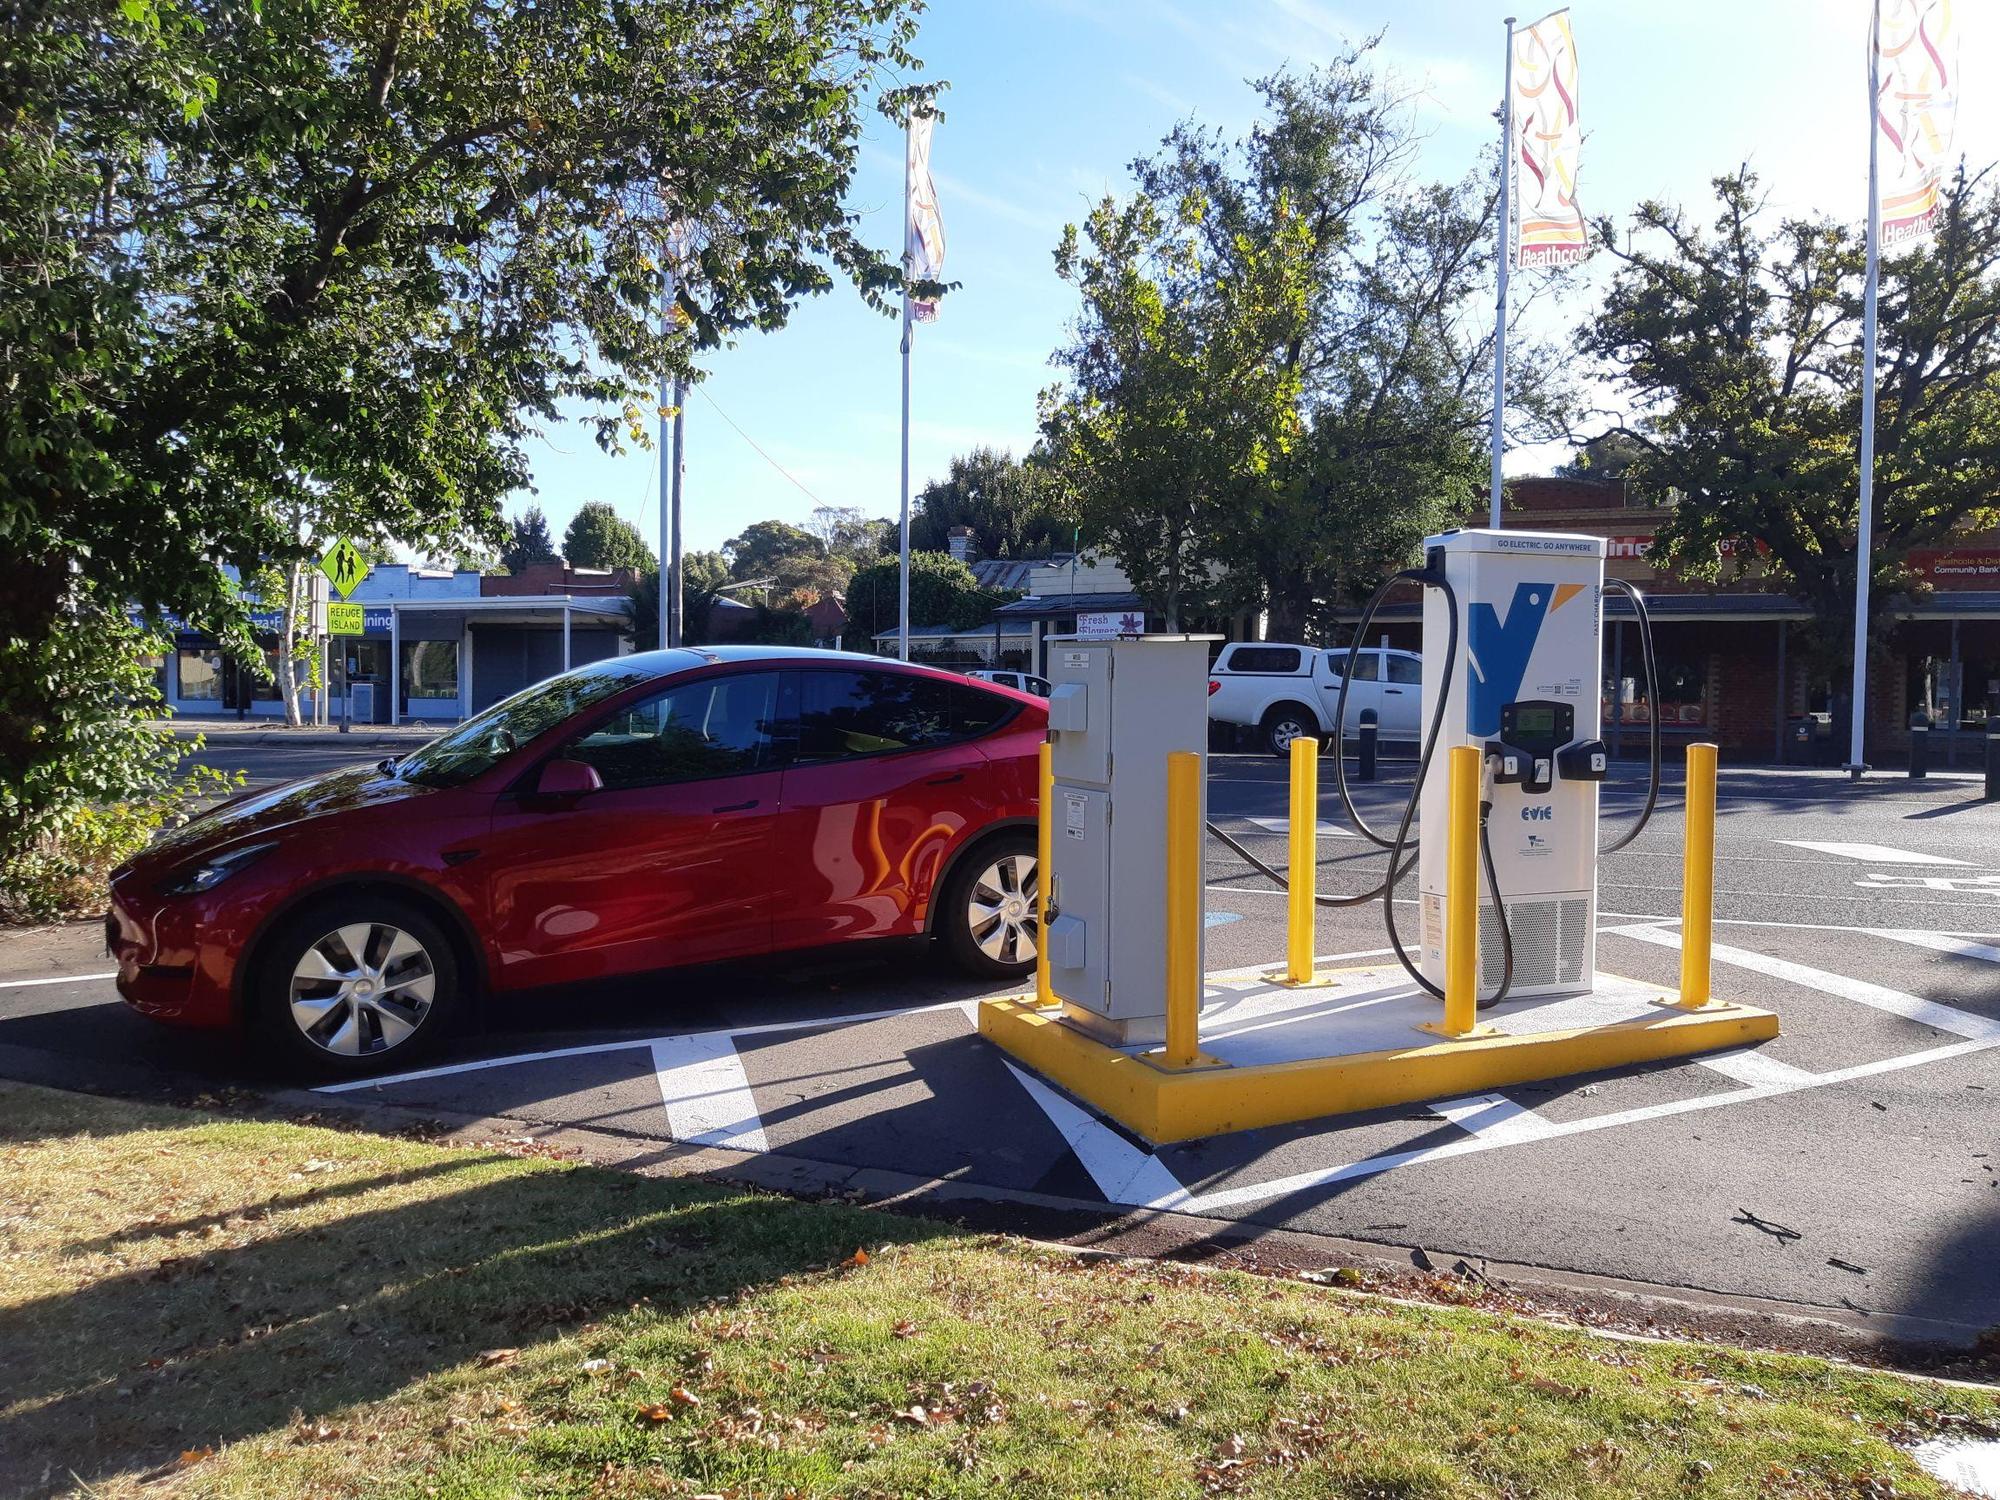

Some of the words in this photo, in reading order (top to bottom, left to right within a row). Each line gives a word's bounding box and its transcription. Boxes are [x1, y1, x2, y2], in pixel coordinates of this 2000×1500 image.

[1498, 540, 1509, 548] GO
[1555, 543, 1592, 552] ANYWHERE
[1935, 566, 1977, 575] Community
[330, 607, 361, 618] REFUGE
[331, 619, 360, 630] ISLAND
[1079, 615, 1108, 626] Fresh
[1508, 760, 1513, 771] 1
[1595, 757, 1601, 768] 2
